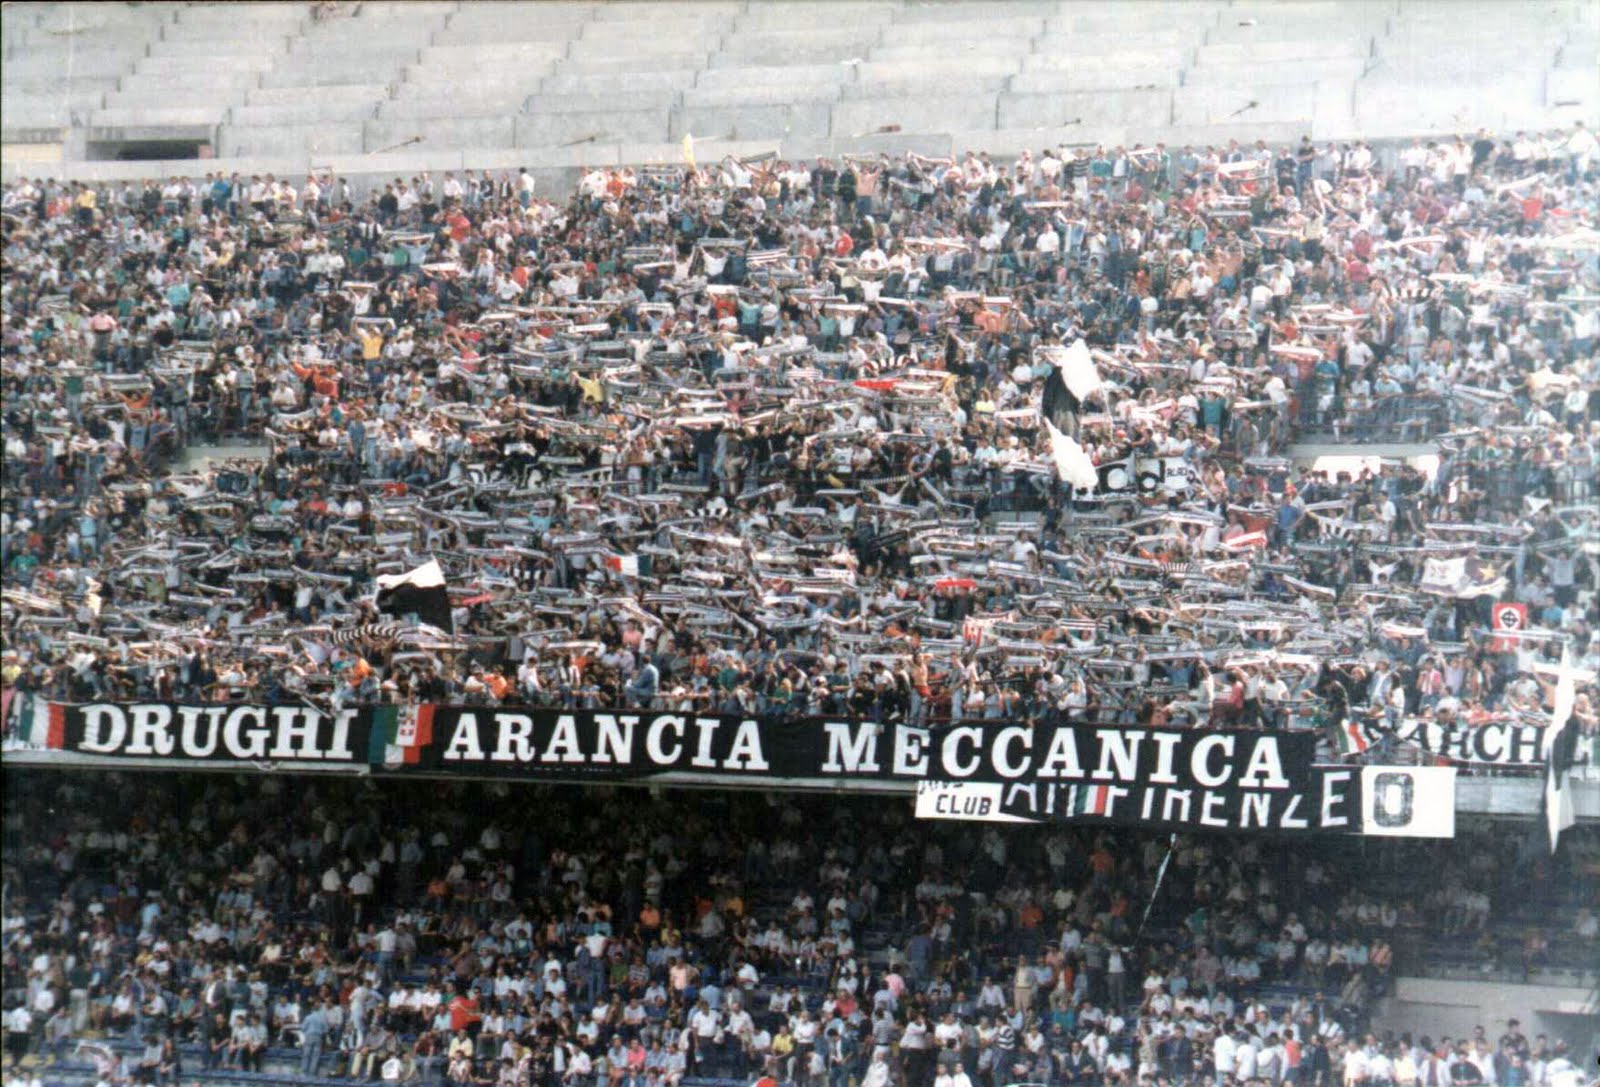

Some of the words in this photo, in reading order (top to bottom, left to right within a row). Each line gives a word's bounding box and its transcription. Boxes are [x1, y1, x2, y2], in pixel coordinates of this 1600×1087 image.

[78, 704, 358, 759] DRUGHI
[443, 713, 769, 771] ARANCIA
[821, 723, 1289, 788] MECCANICA
[936, 794, 993, 816] CLUB
